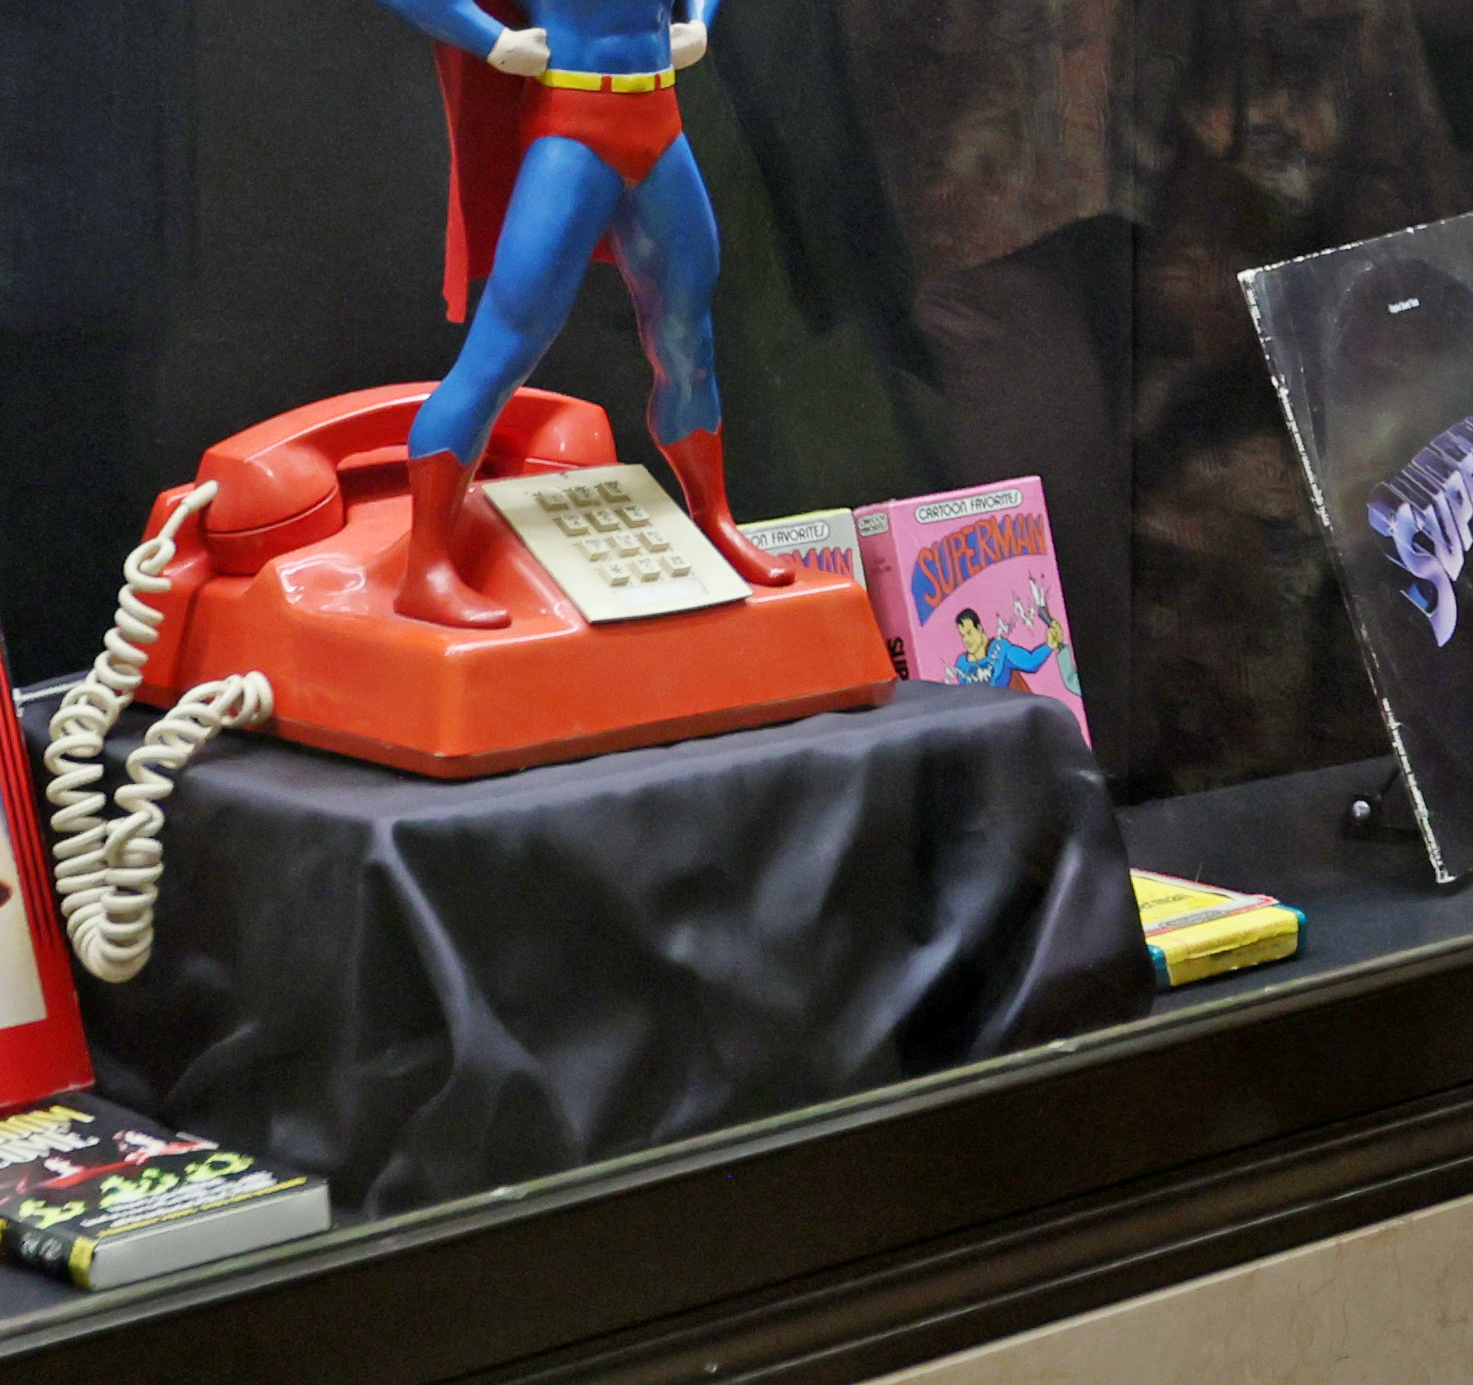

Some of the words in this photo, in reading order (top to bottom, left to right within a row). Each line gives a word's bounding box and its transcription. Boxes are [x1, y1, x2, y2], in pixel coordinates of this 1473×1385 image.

[918, 501, 967, 520] CARTOON
[970, 492, 1019, 511] FAVORITES
[772, 525, 825, 544] FAVORITES
[918, 513, 1047, 607] SUPERMAN
